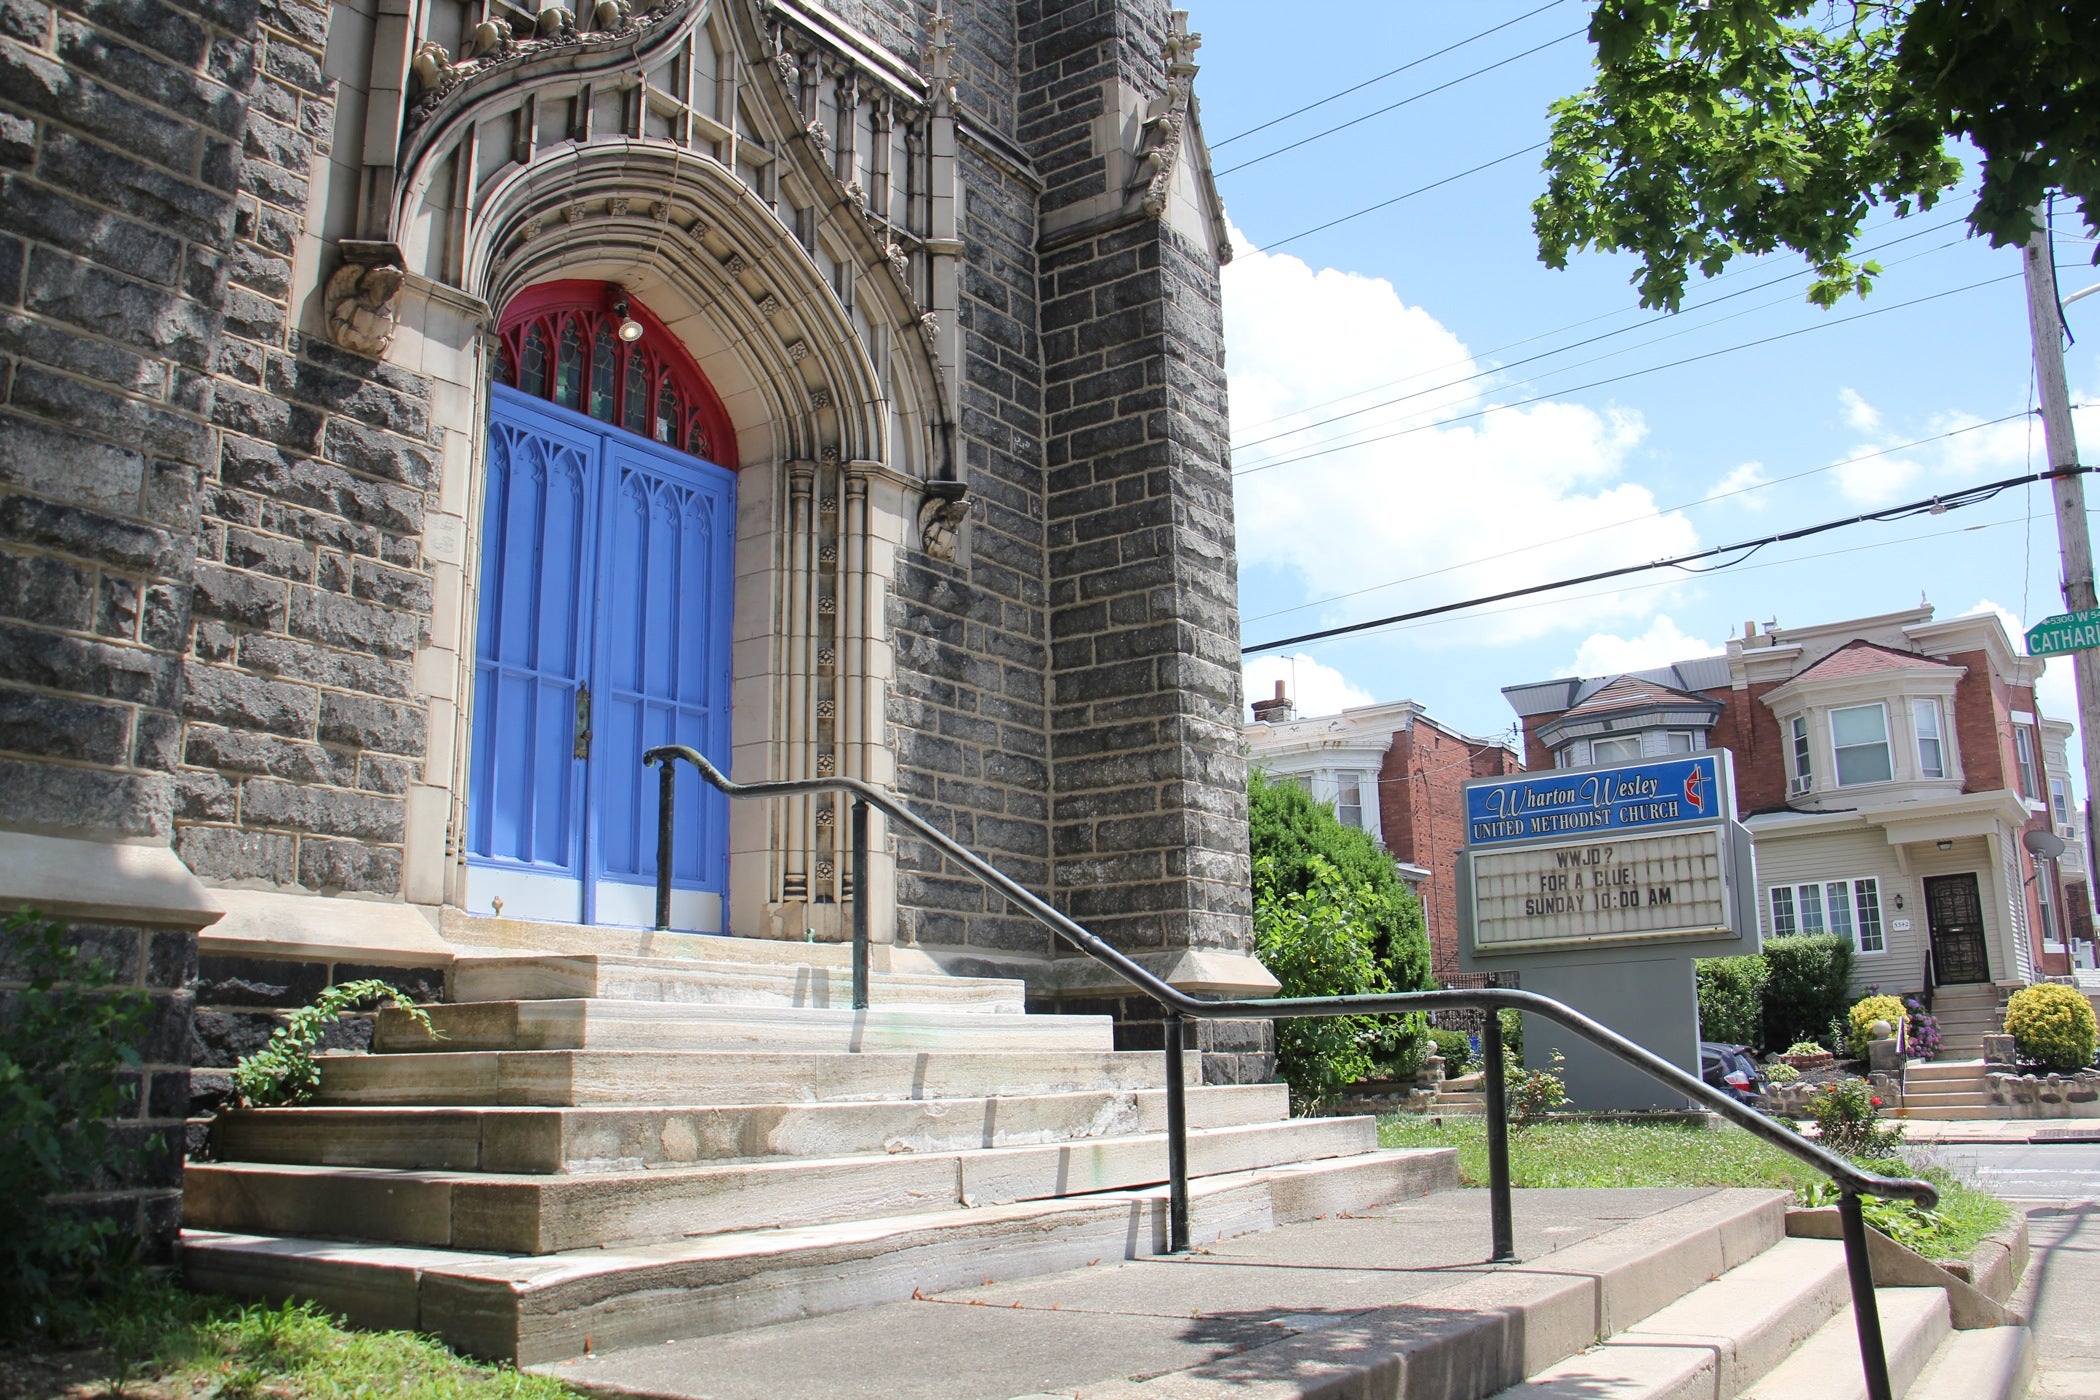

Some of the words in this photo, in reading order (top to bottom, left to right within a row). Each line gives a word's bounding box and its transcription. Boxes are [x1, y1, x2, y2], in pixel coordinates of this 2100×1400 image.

[2050, 615, 2073, 625] 5300
[2076, 611, 2088, 622] W
[1485, 785, 1576, 819] Wharton
[1580, 774, 1658, 808] Wesley
[1473, 819, 1524, 839] UNITED
[1530, 808, 1611, 833] METHODIST
[1619, 800, 1679, 823] CHURCH
[1540, 875, 1567, 892] FOR
[1575, 873, 1584, 889] A
[1525, 895, 1584, 915] SUNDAY
[1596, 890, 1640, 910] 10:00
[1649, 887, 1672, 905] AM
